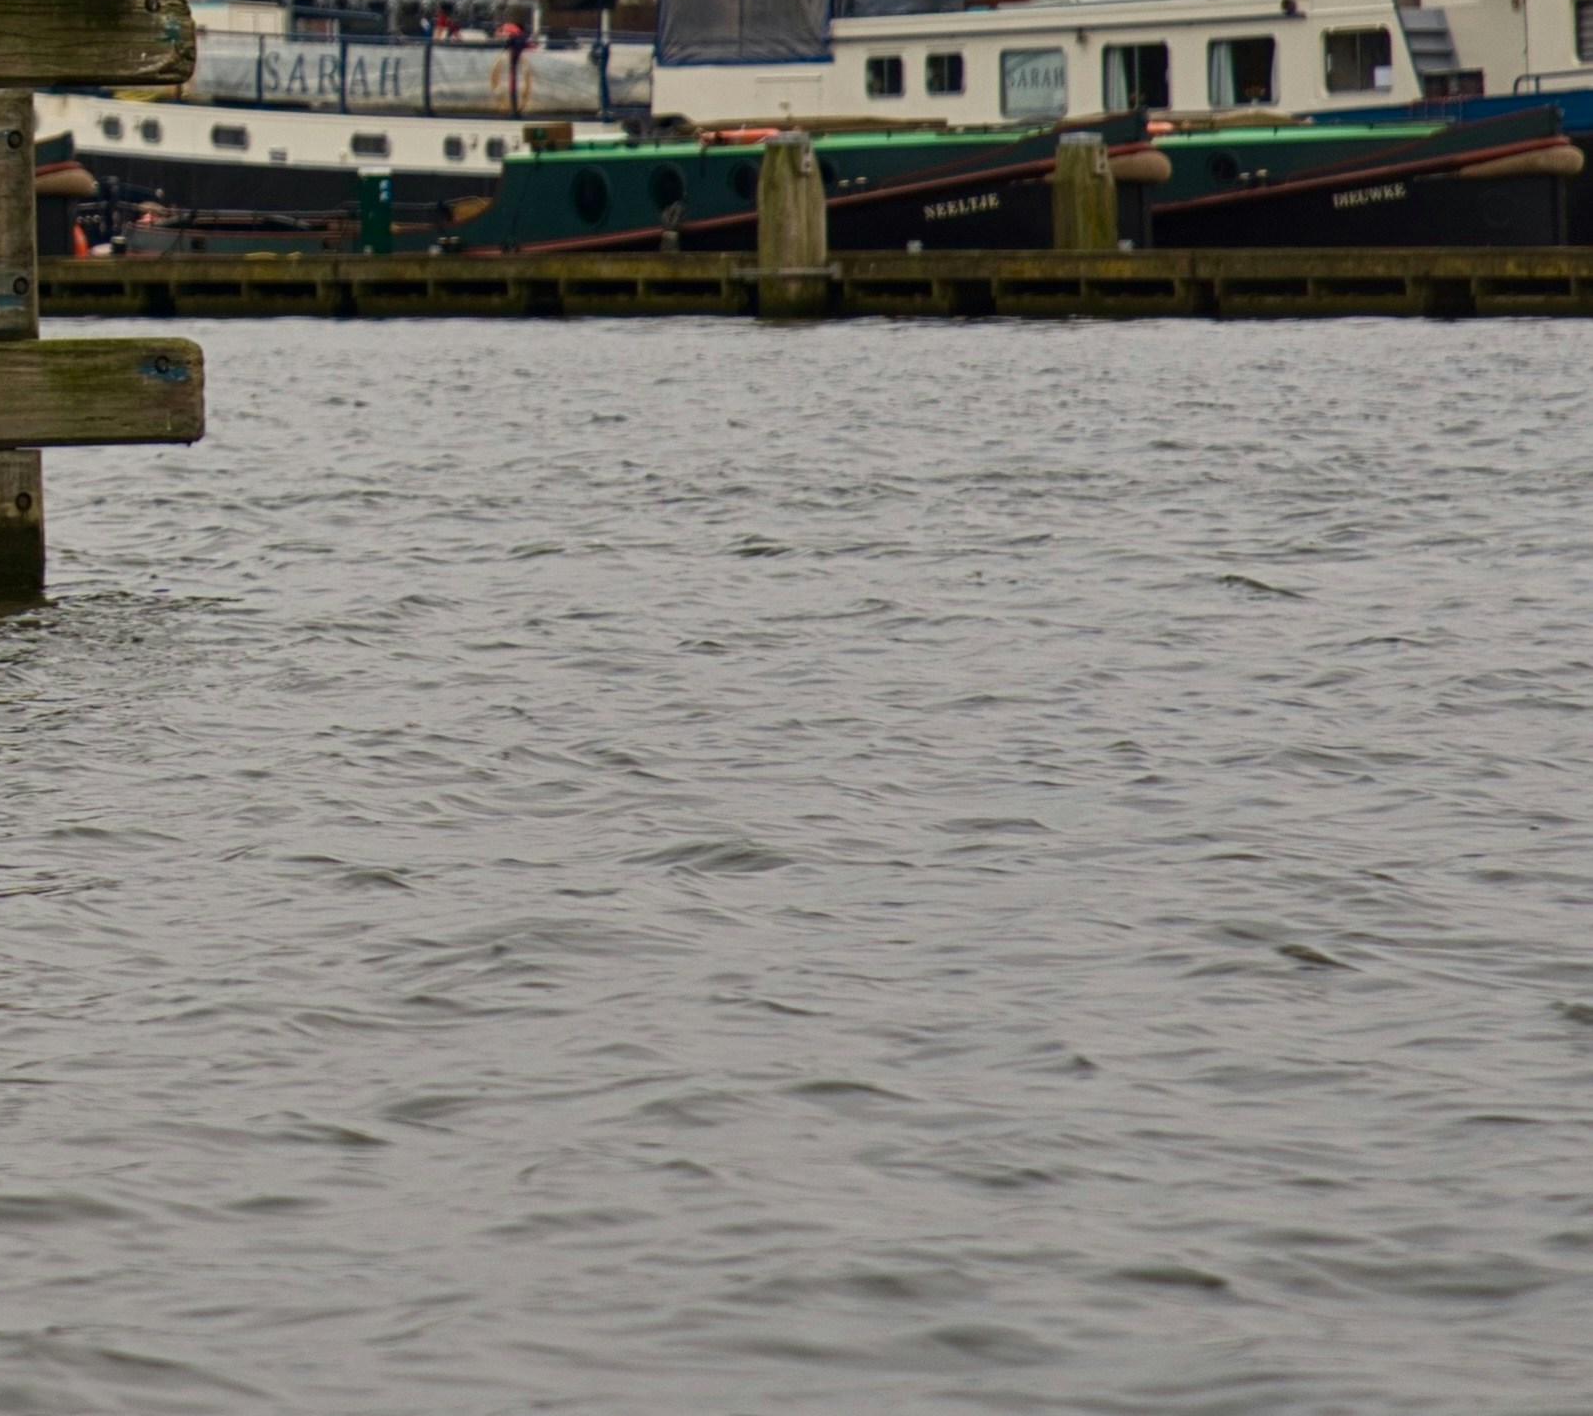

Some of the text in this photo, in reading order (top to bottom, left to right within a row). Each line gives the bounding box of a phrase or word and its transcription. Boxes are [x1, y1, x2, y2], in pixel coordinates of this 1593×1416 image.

[264, 50, 402, 98] SARAH
[1006, 66, 1065, 89] SARAH
[923, 192, 1000, 221] NEELTJE
